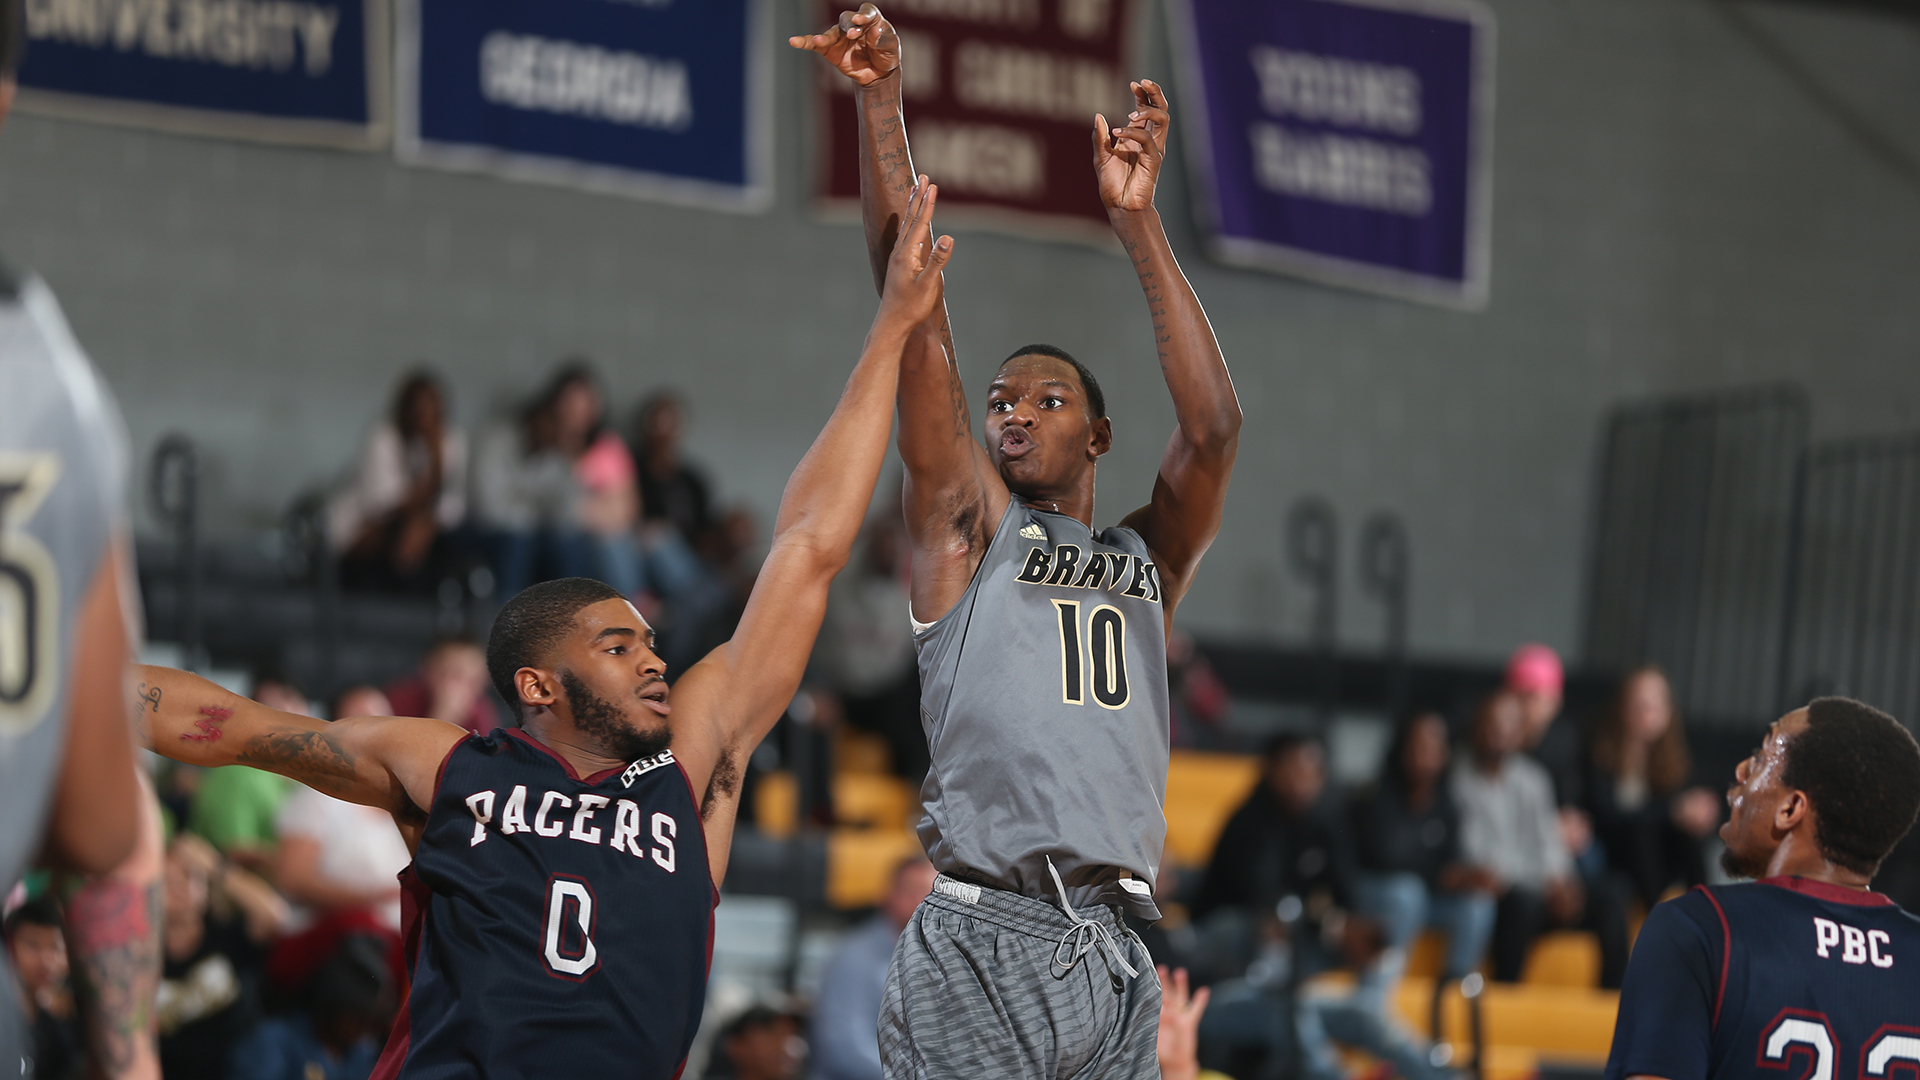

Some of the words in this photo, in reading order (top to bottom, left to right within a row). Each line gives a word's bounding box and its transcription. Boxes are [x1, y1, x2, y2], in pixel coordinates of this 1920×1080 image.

[1050, 599, 1131, 710] 10
[621, 749, 676, 789] PBC
[465, 785, 677, 873] PACERS
[540, 873, 600, 982] 0
[1813, 916, 1893, 968] PBC
